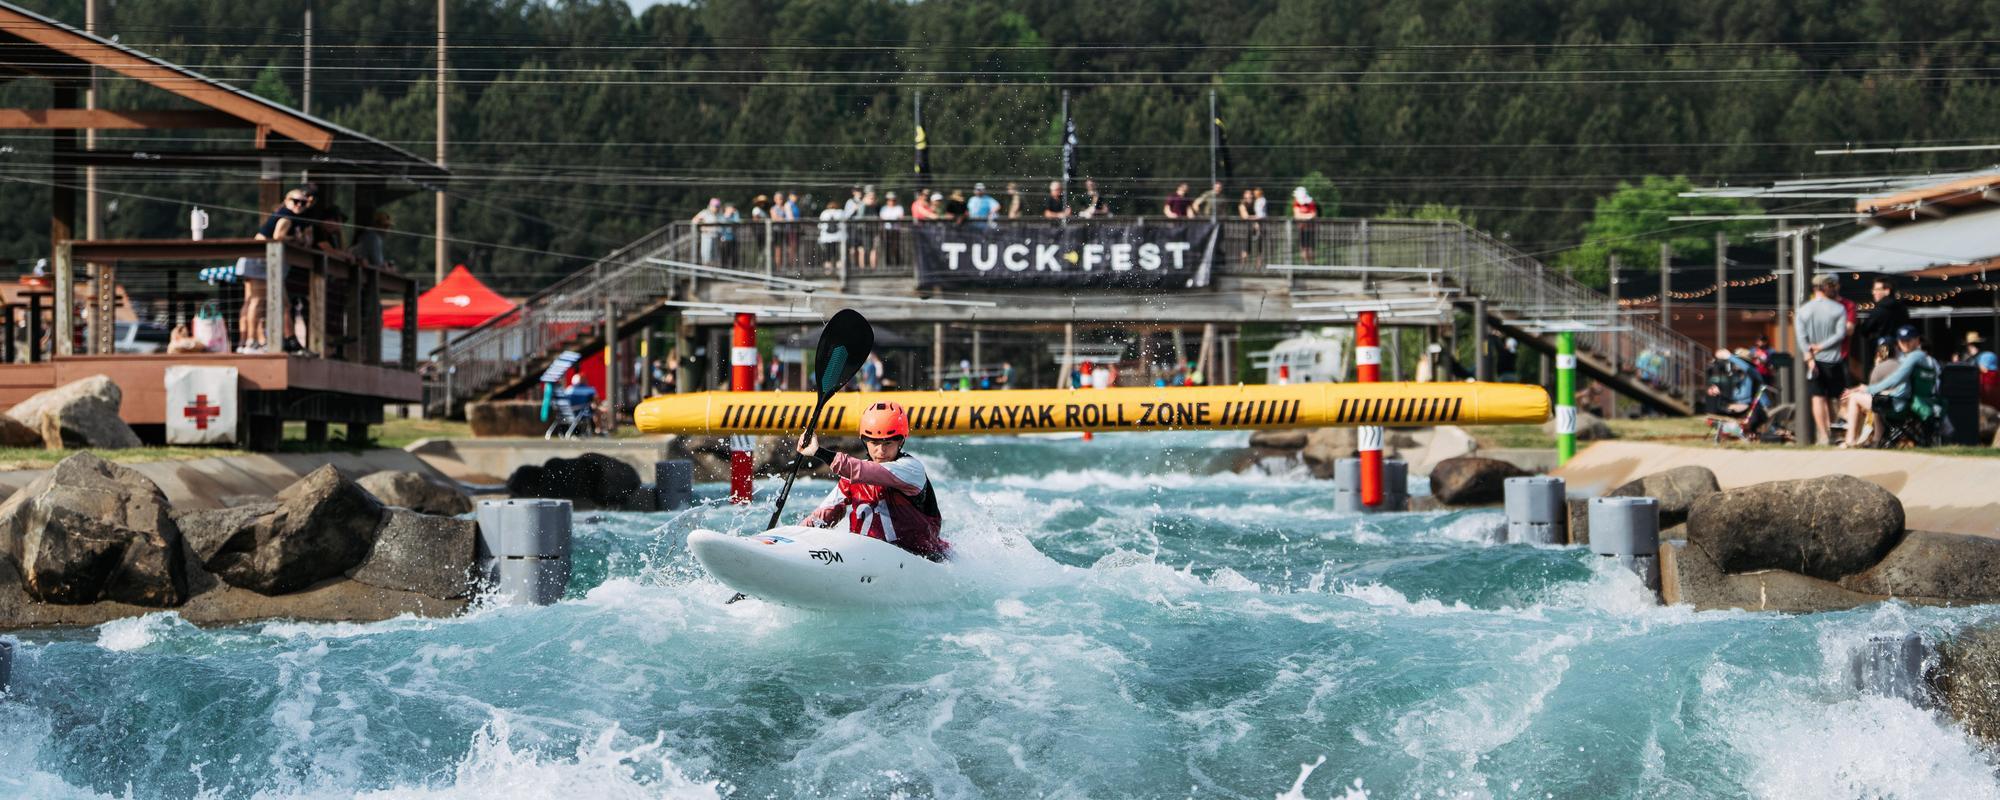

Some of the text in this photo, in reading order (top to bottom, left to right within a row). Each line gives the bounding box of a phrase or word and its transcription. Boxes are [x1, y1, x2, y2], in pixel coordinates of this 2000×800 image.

[940, 242, 1191, 272] TUCK FEST
[970, 402, 1211, 430] KAYAK ROLL ZONE
[808, 548, 844, 565] RTM
